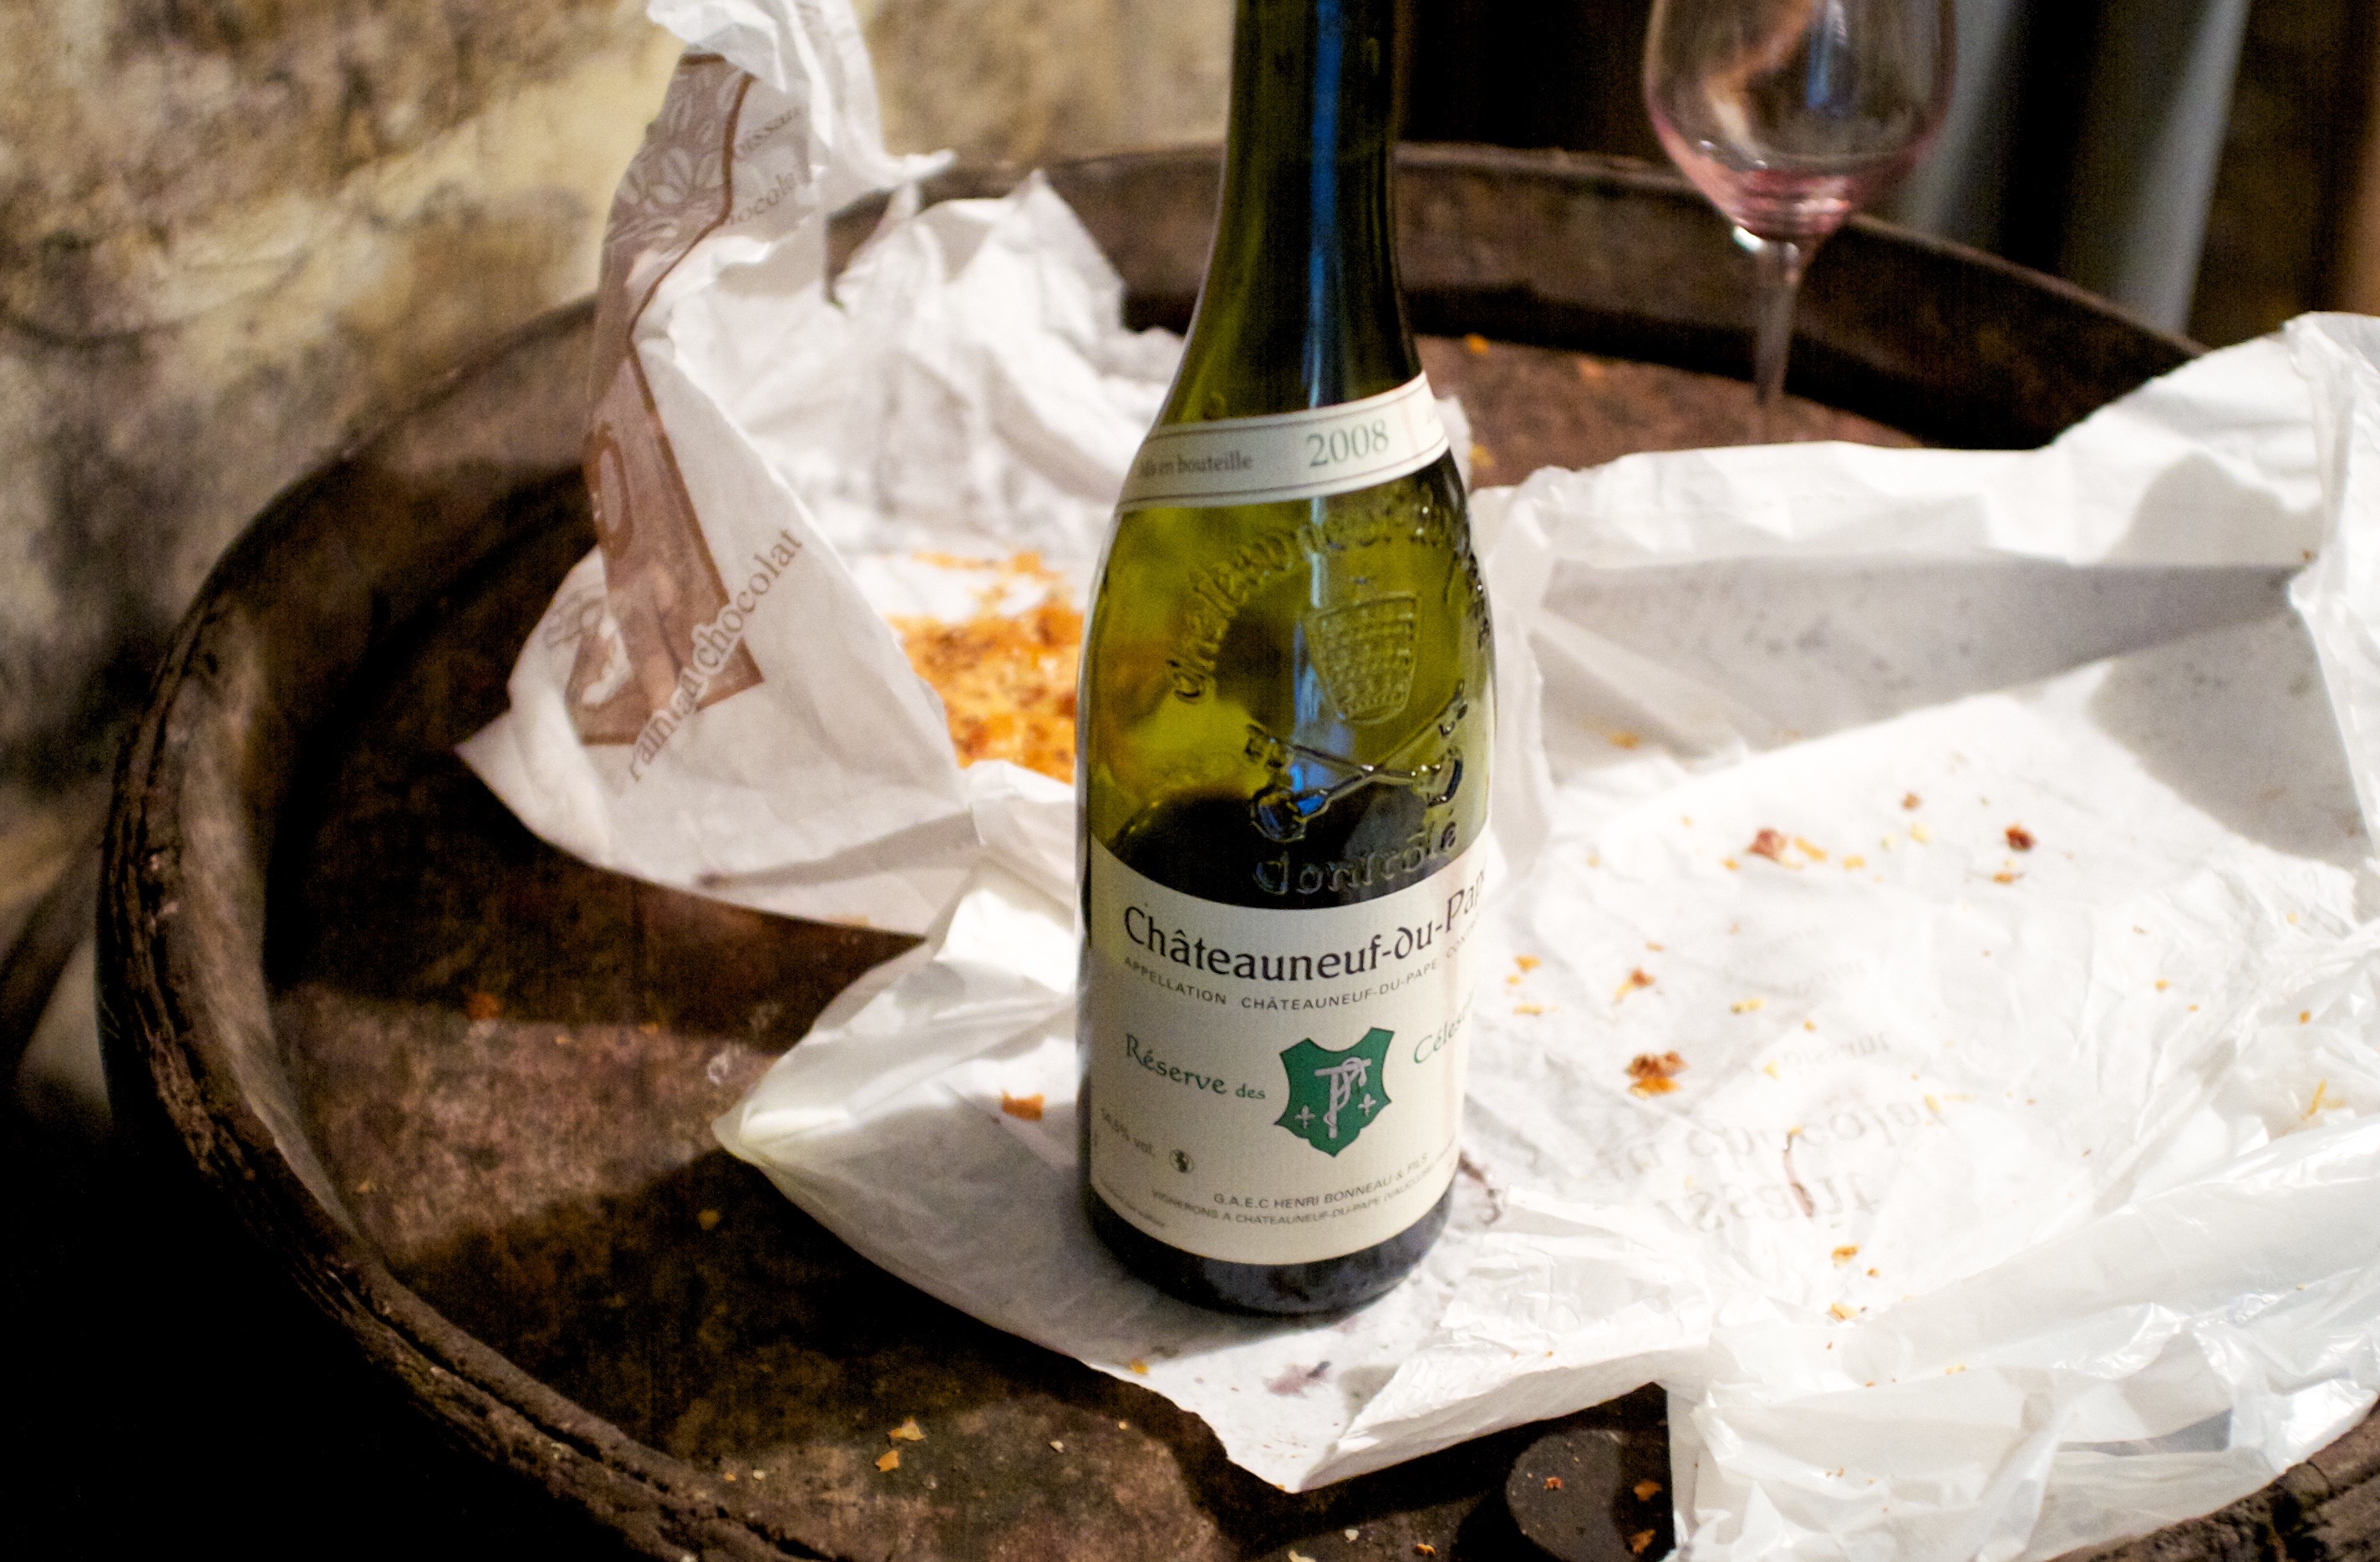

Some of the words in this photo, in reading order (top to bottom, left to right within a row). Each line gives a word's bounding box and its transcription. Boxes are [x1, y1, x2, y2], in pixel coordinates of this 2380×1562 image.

[1177, 450, 1253, 474] bouteille
[1306, 419, 1389, 467] 2008
[697, 529, 803, 669] chocolat
[1124, 861, 1485, 981] Châteauneuf-du-Pap
[1124, 956, 1227, 1005] APPELLATION
[1241, 958, 1439, 1011] CHÂTEAUNEUF-DU-PAPE
[1126, 1033, 1227, 1095] Réserve
[1235, 1083, 1266, 1101] des
[1152, 1187, 1218, 1219] VIGNERONS
[1274, 1195, 1320, 1209] HENRI
[1324, 1174, 1392, 1204] BONNEAU
